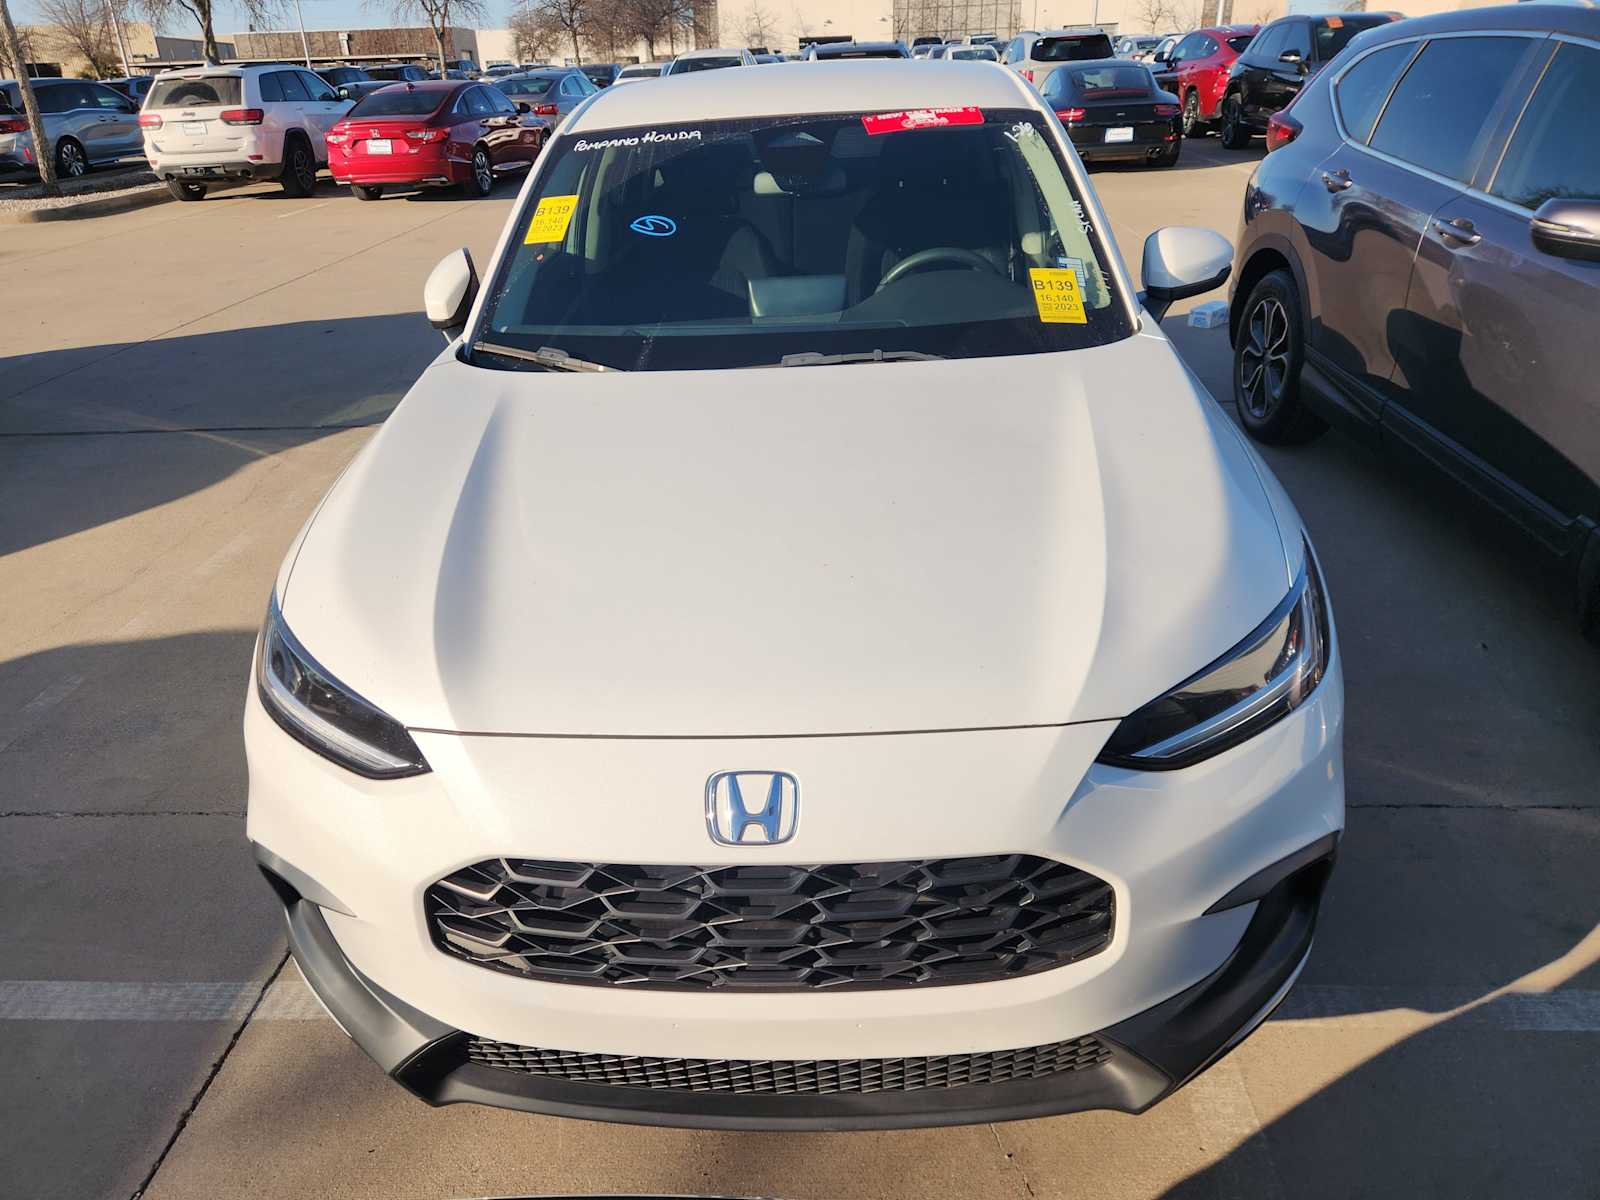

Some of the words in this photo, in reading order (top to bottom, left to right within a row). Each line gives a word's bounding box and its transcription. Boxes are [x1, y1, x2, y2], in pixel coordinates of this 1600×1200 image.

[641, 130, 702, 144] HONDA
[536, 205, 570, 217] B139
[1034, 280, 1073, 291] B139
[1040, 294, 1074, 303] 16,140
[1055, 302, 1079, 311] 2023
